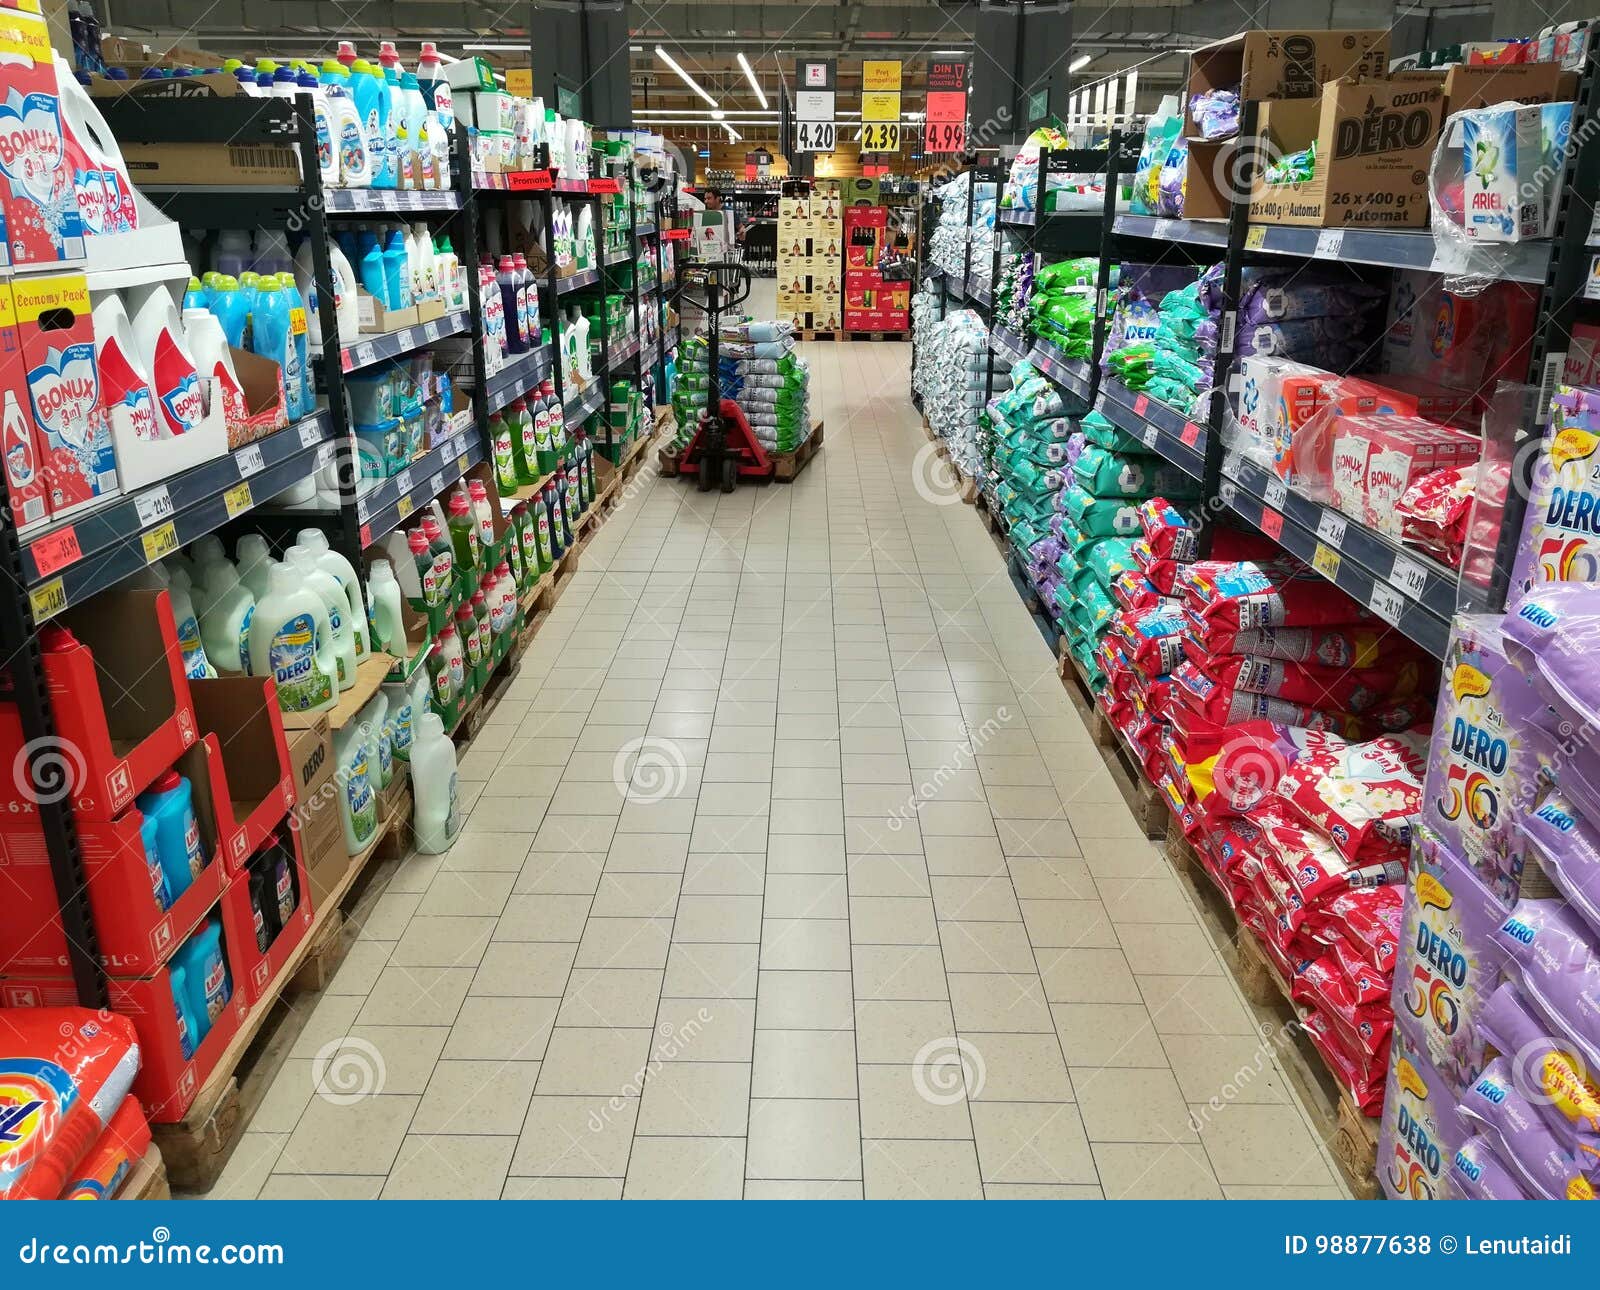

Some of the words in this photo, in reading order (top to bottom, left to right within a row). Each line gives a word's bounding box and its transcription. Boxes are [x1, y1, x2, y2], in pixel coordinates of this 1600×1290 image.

[934, 64, 951, 73] DIN
[1284, 35, 1315, 99] ERO
[0, 126, 59, 160] BONUX
[799, 124, 833, 149] 4.20
[864, 125, 898, 149] 2.39
[928, 125, 962, 150] 4.99
[1334, 109, 1432, 160] DERO
[1251, 204, 1259, 216] 26
[1264, 204, 1277, 216] 400
[1289, 203, 1320, 217] Automat
[1332, 193, 1350, 205] 26
[1354, 196, 1362, 204] x
[1366, 193, 1393, 205] 400
[1397, 195, 1406, 207] g
[1473, 192, 1503, 211] ARIEL
[1343, 210, 1408, 222] Automat
[17, 292, 60, 308] Economy
[1125, 325, 1157, 340] DER
[37, 377, 95, 421] BONUX
[1240, 414, 1259, 436] AREL
[1519, 602, 1558, 630] DERO
[187, 665, 206, 680] ERO
[277, 657, 312, 684] DERO
[1374, 737, 1427, 781] ONU
[1451, 715, 1509, 777] DERO
[302, 743, 325, 787] DERO
[9, 801, 20, 813] 6
[1437, 762, 1500, 830] 50
[1536, 803, 1577, 834] DERO
[1502, 917, 1537, 947] DERO
[1415, 920, 1469, 990] DERO
[1403, 963, 1461, 1036] 50
[1475, 1078, 1507, 1106] DERO
[1396, 1103, 1441, 1178] DERO
[1455, 1151, 1482, 1183] DERO
